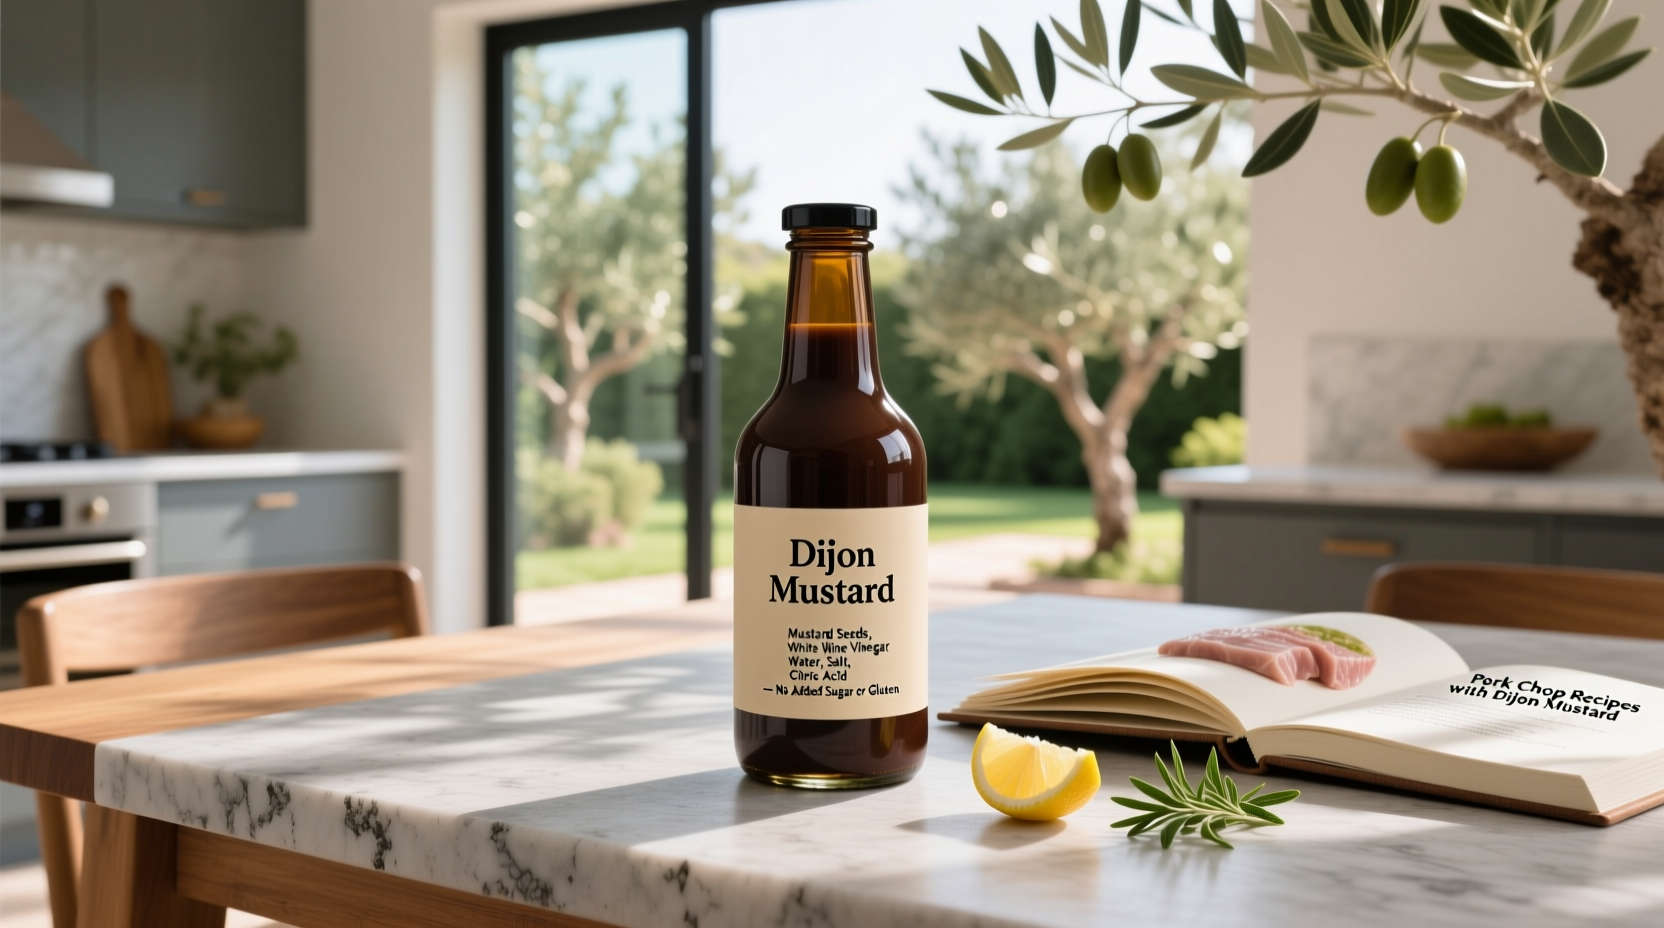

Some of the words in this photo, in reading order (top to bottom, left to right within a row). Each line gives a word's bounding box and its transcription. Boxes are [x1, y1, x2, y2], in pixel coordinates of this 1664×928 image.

[789, 539, 876, 576] Dijon
[769, 574, 895, 604] Mustard
[788, 627, 833, 639] Mustard
[788, 642, 818, 653] White
[850, 641, 890, 656] Vinegar
[788, 656, 823, 669] Water,
[825, 686, 853, 699] Sugar
[868, 683, 900, 695] Gluten
[1449, 684, 1488, 698] with
[1492, 690, 1539, 706] Dijon
[1543, 698, 1620, 721] Mustard
[1470, 673, 1513, 690] Pork
[1517, 680, 1566, 700] Chop
[1570, 690, 1641, 713] Recipes
